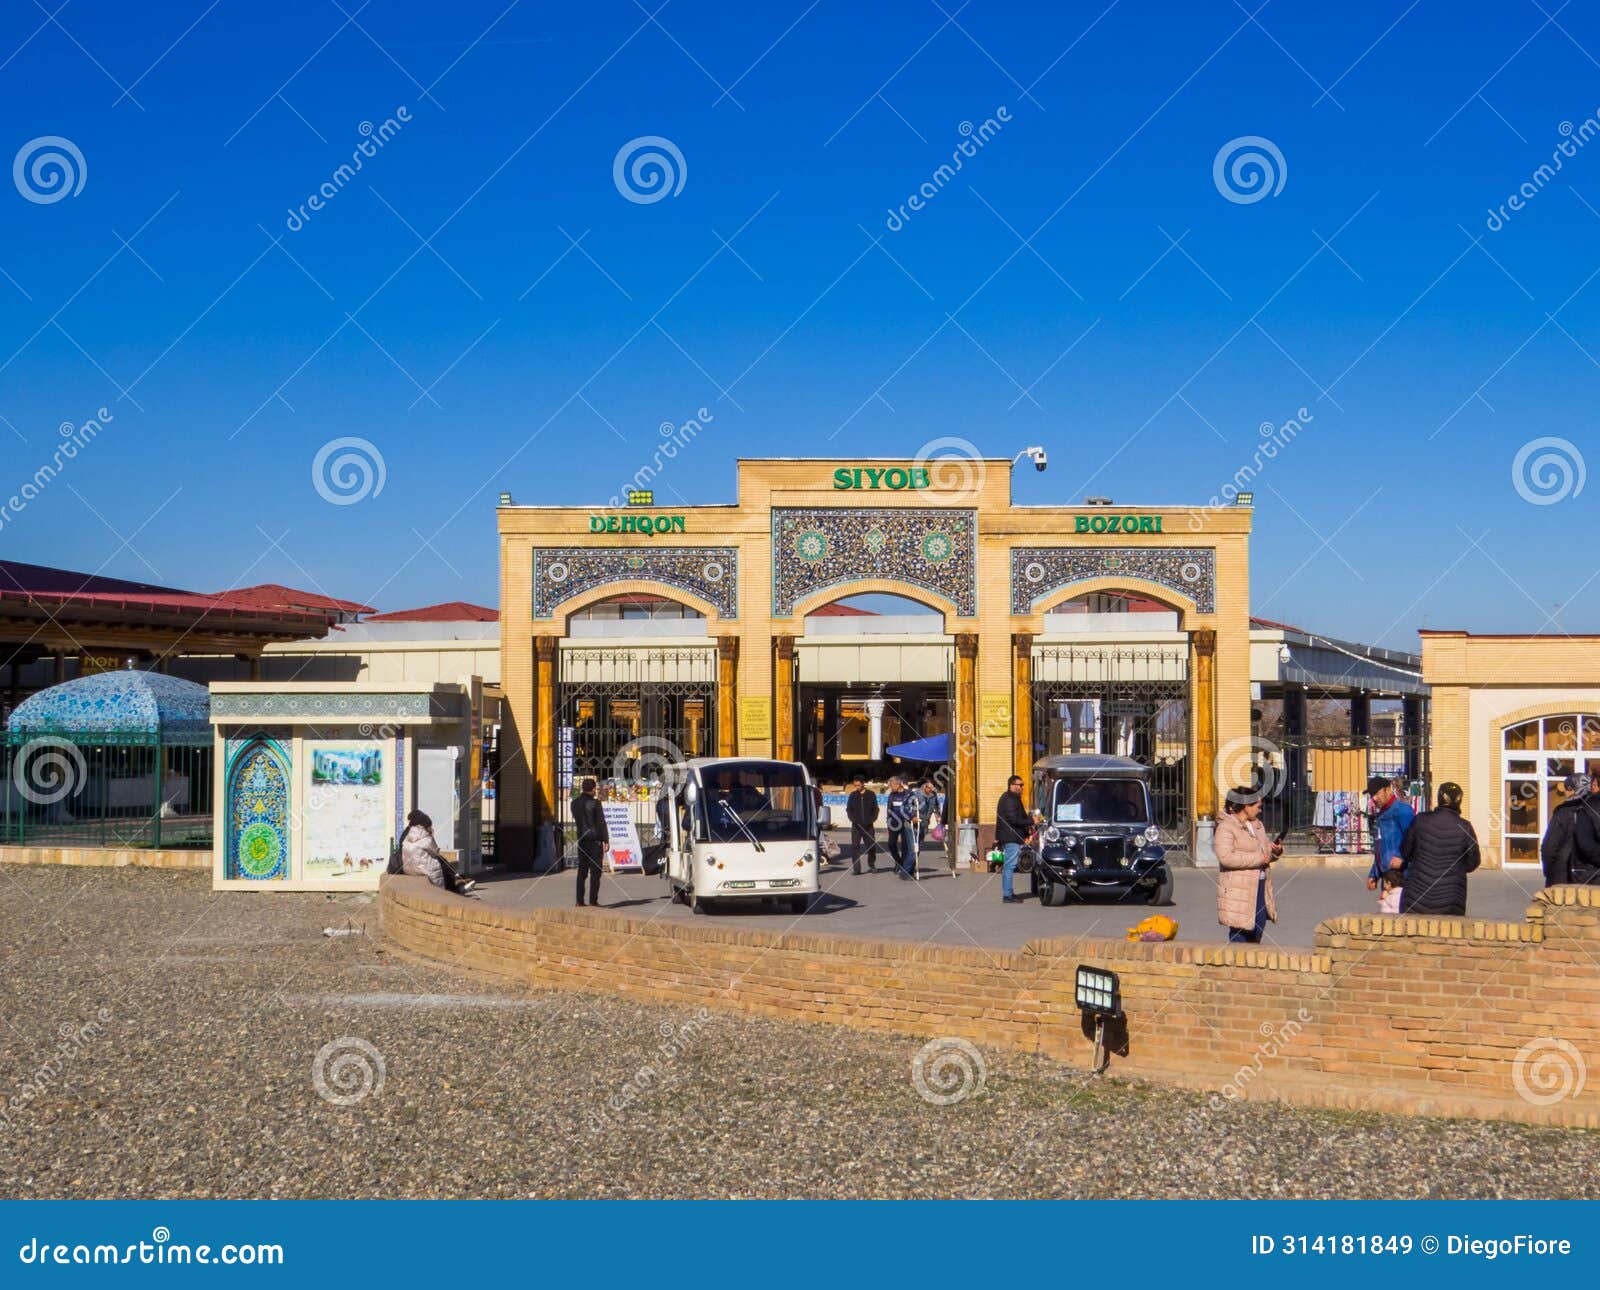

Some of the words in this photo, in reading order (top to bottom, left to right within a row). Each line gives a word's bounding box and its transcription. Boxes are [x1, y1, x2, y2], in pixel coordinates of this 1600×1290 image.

[833, 467, 930, 489] SIYOB
[590, 515, 685, 536] DEHQON
[1074, 515, 1162, 533] BOZORI
